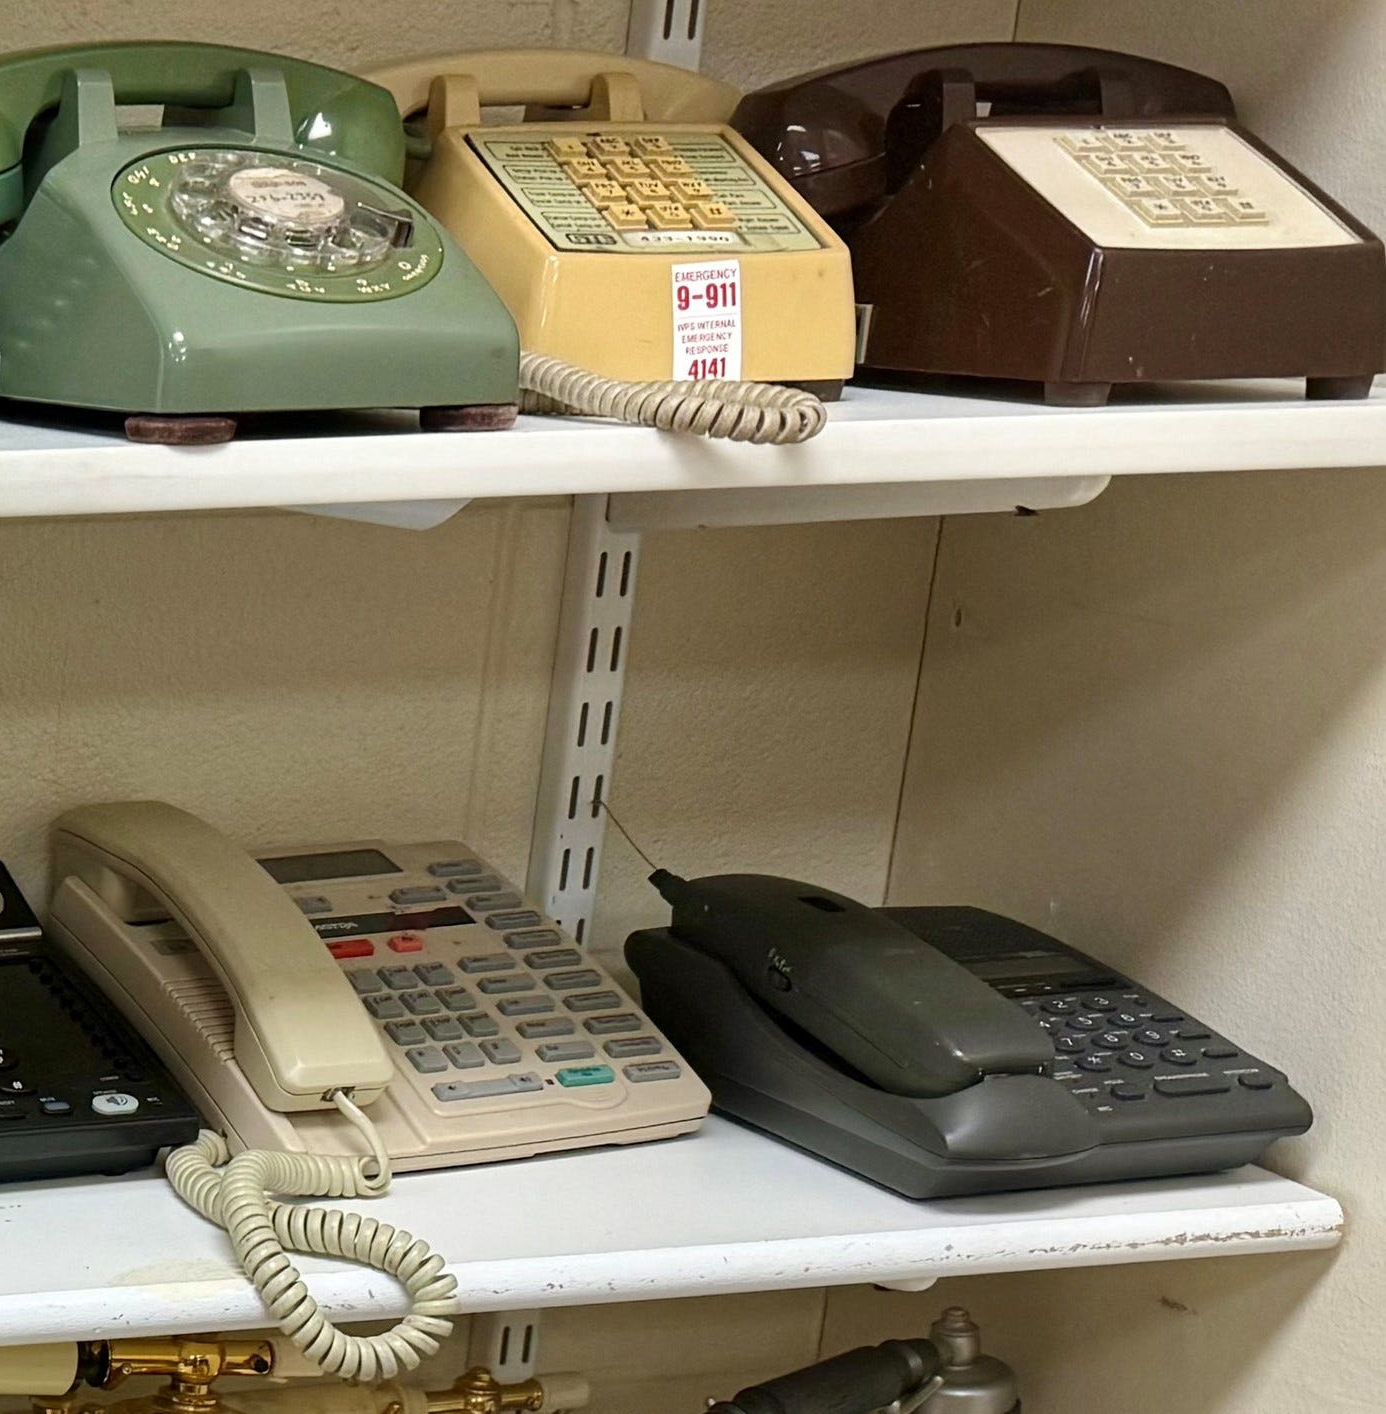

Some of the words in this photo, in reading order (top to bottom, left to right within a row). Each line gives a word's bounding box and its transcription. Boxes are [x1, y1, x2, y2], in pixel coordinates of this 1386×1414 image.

[675, 268, 737, 283] EMERGENCY
[677, 282, 736, 311] 9-911
[697, 319, 736, 331] INTERNAL
[681, 332, 732, 344] EMERGENCY
[685, 343, 729, 355] RESPONSE
[688, 356, 726, 381] 4141
